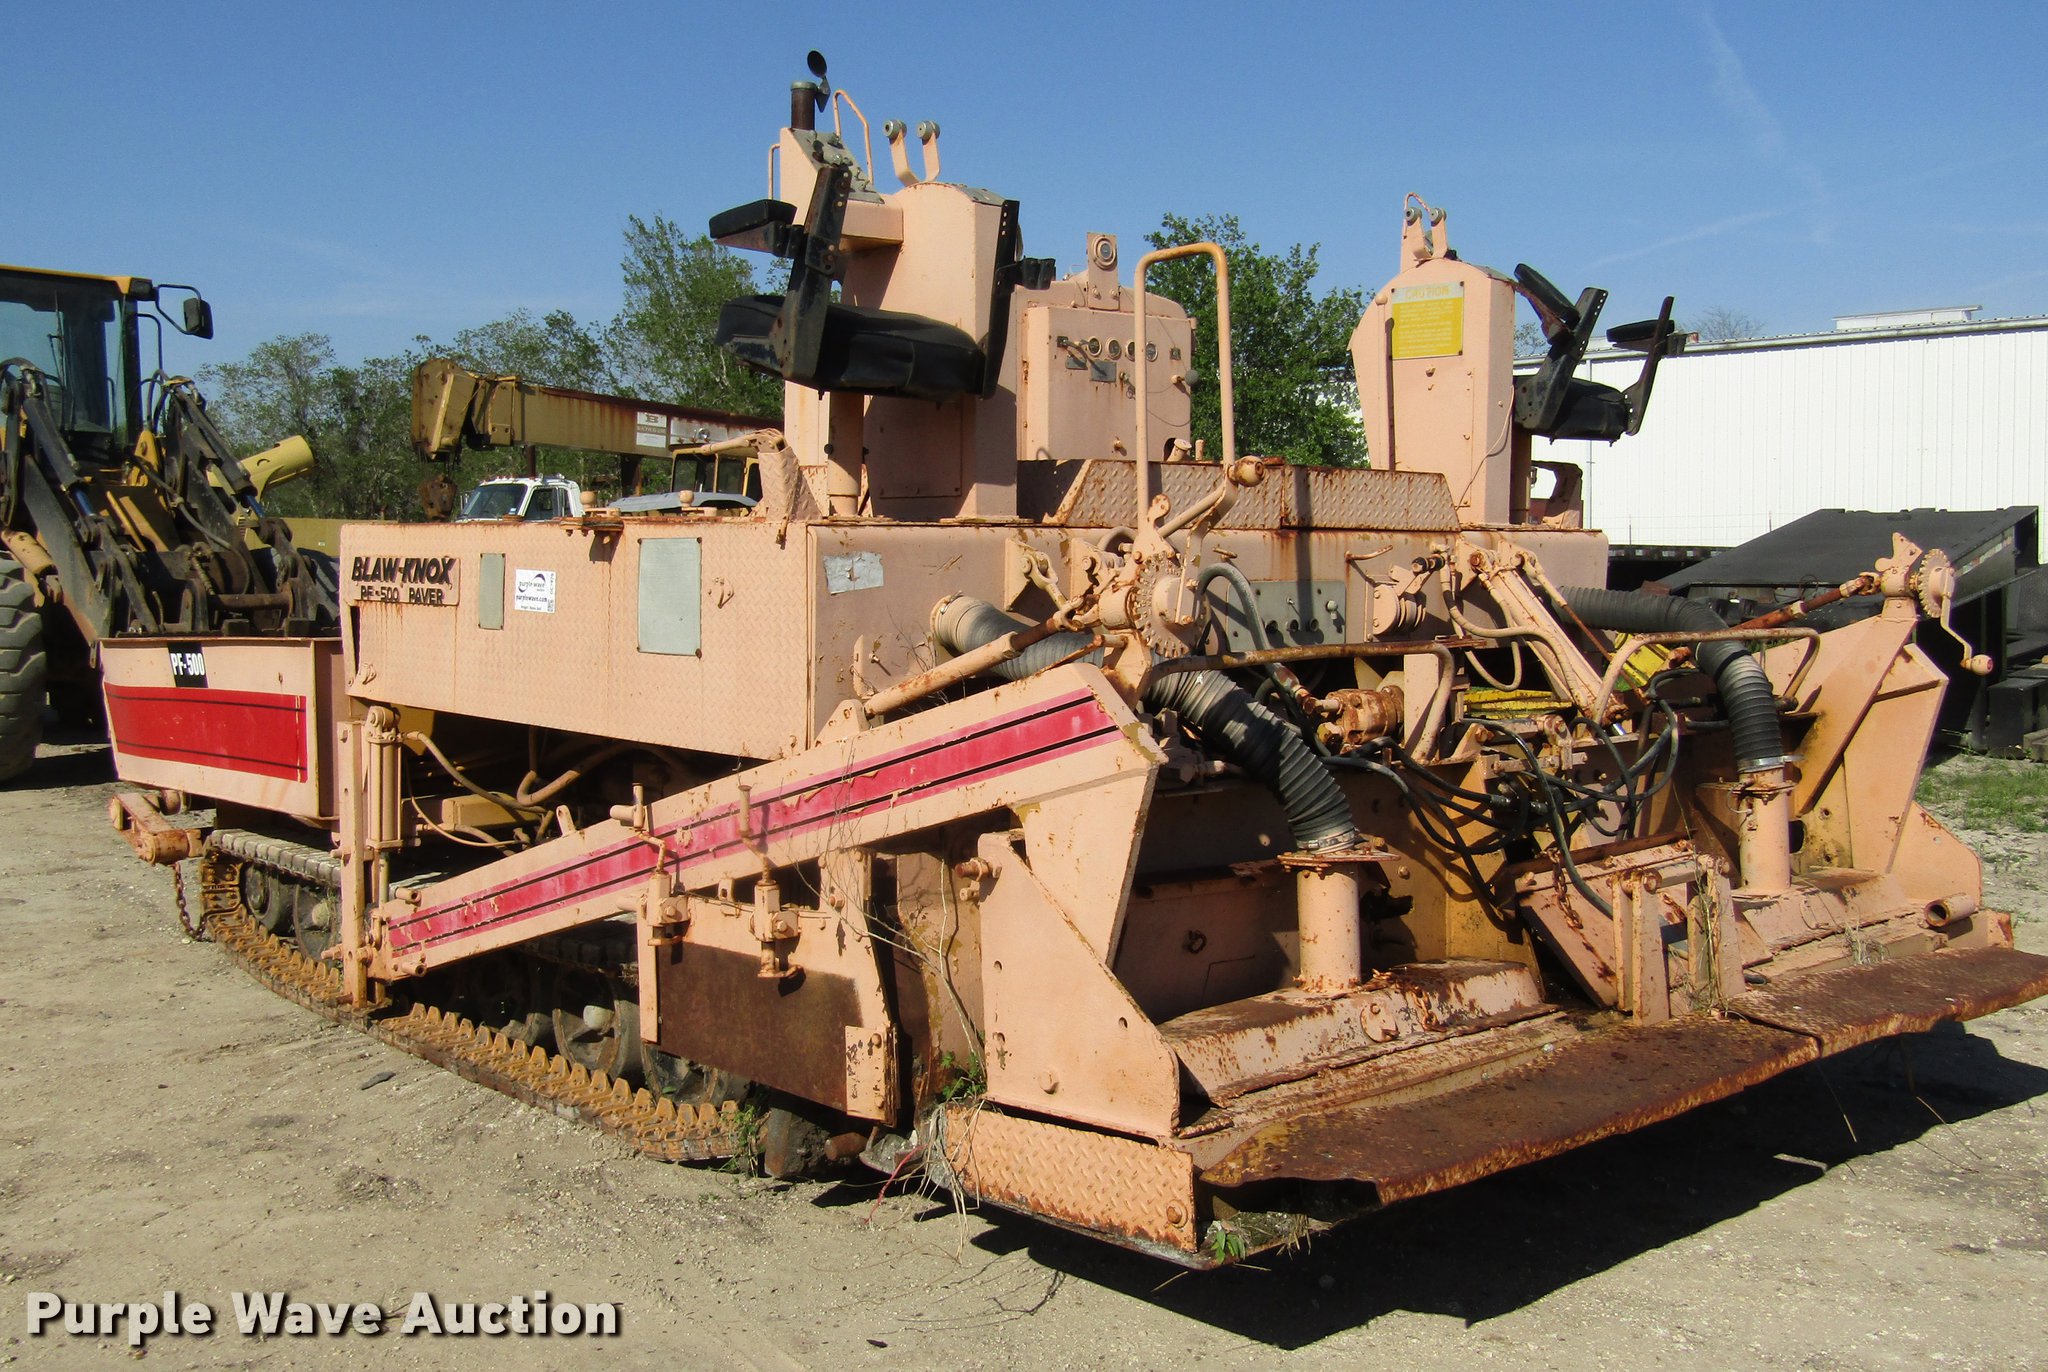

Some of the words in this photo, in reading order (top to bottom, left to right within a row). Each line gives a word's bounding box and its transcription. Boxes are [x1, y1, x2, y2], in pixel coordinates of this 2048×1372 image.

[352, 556, 456, 585] BLAW-KNOX
[361, 585, 400, 602] PF-500
[409, 587, 444, 605] PAVER
[170, 652, 206, 676] PF-500
